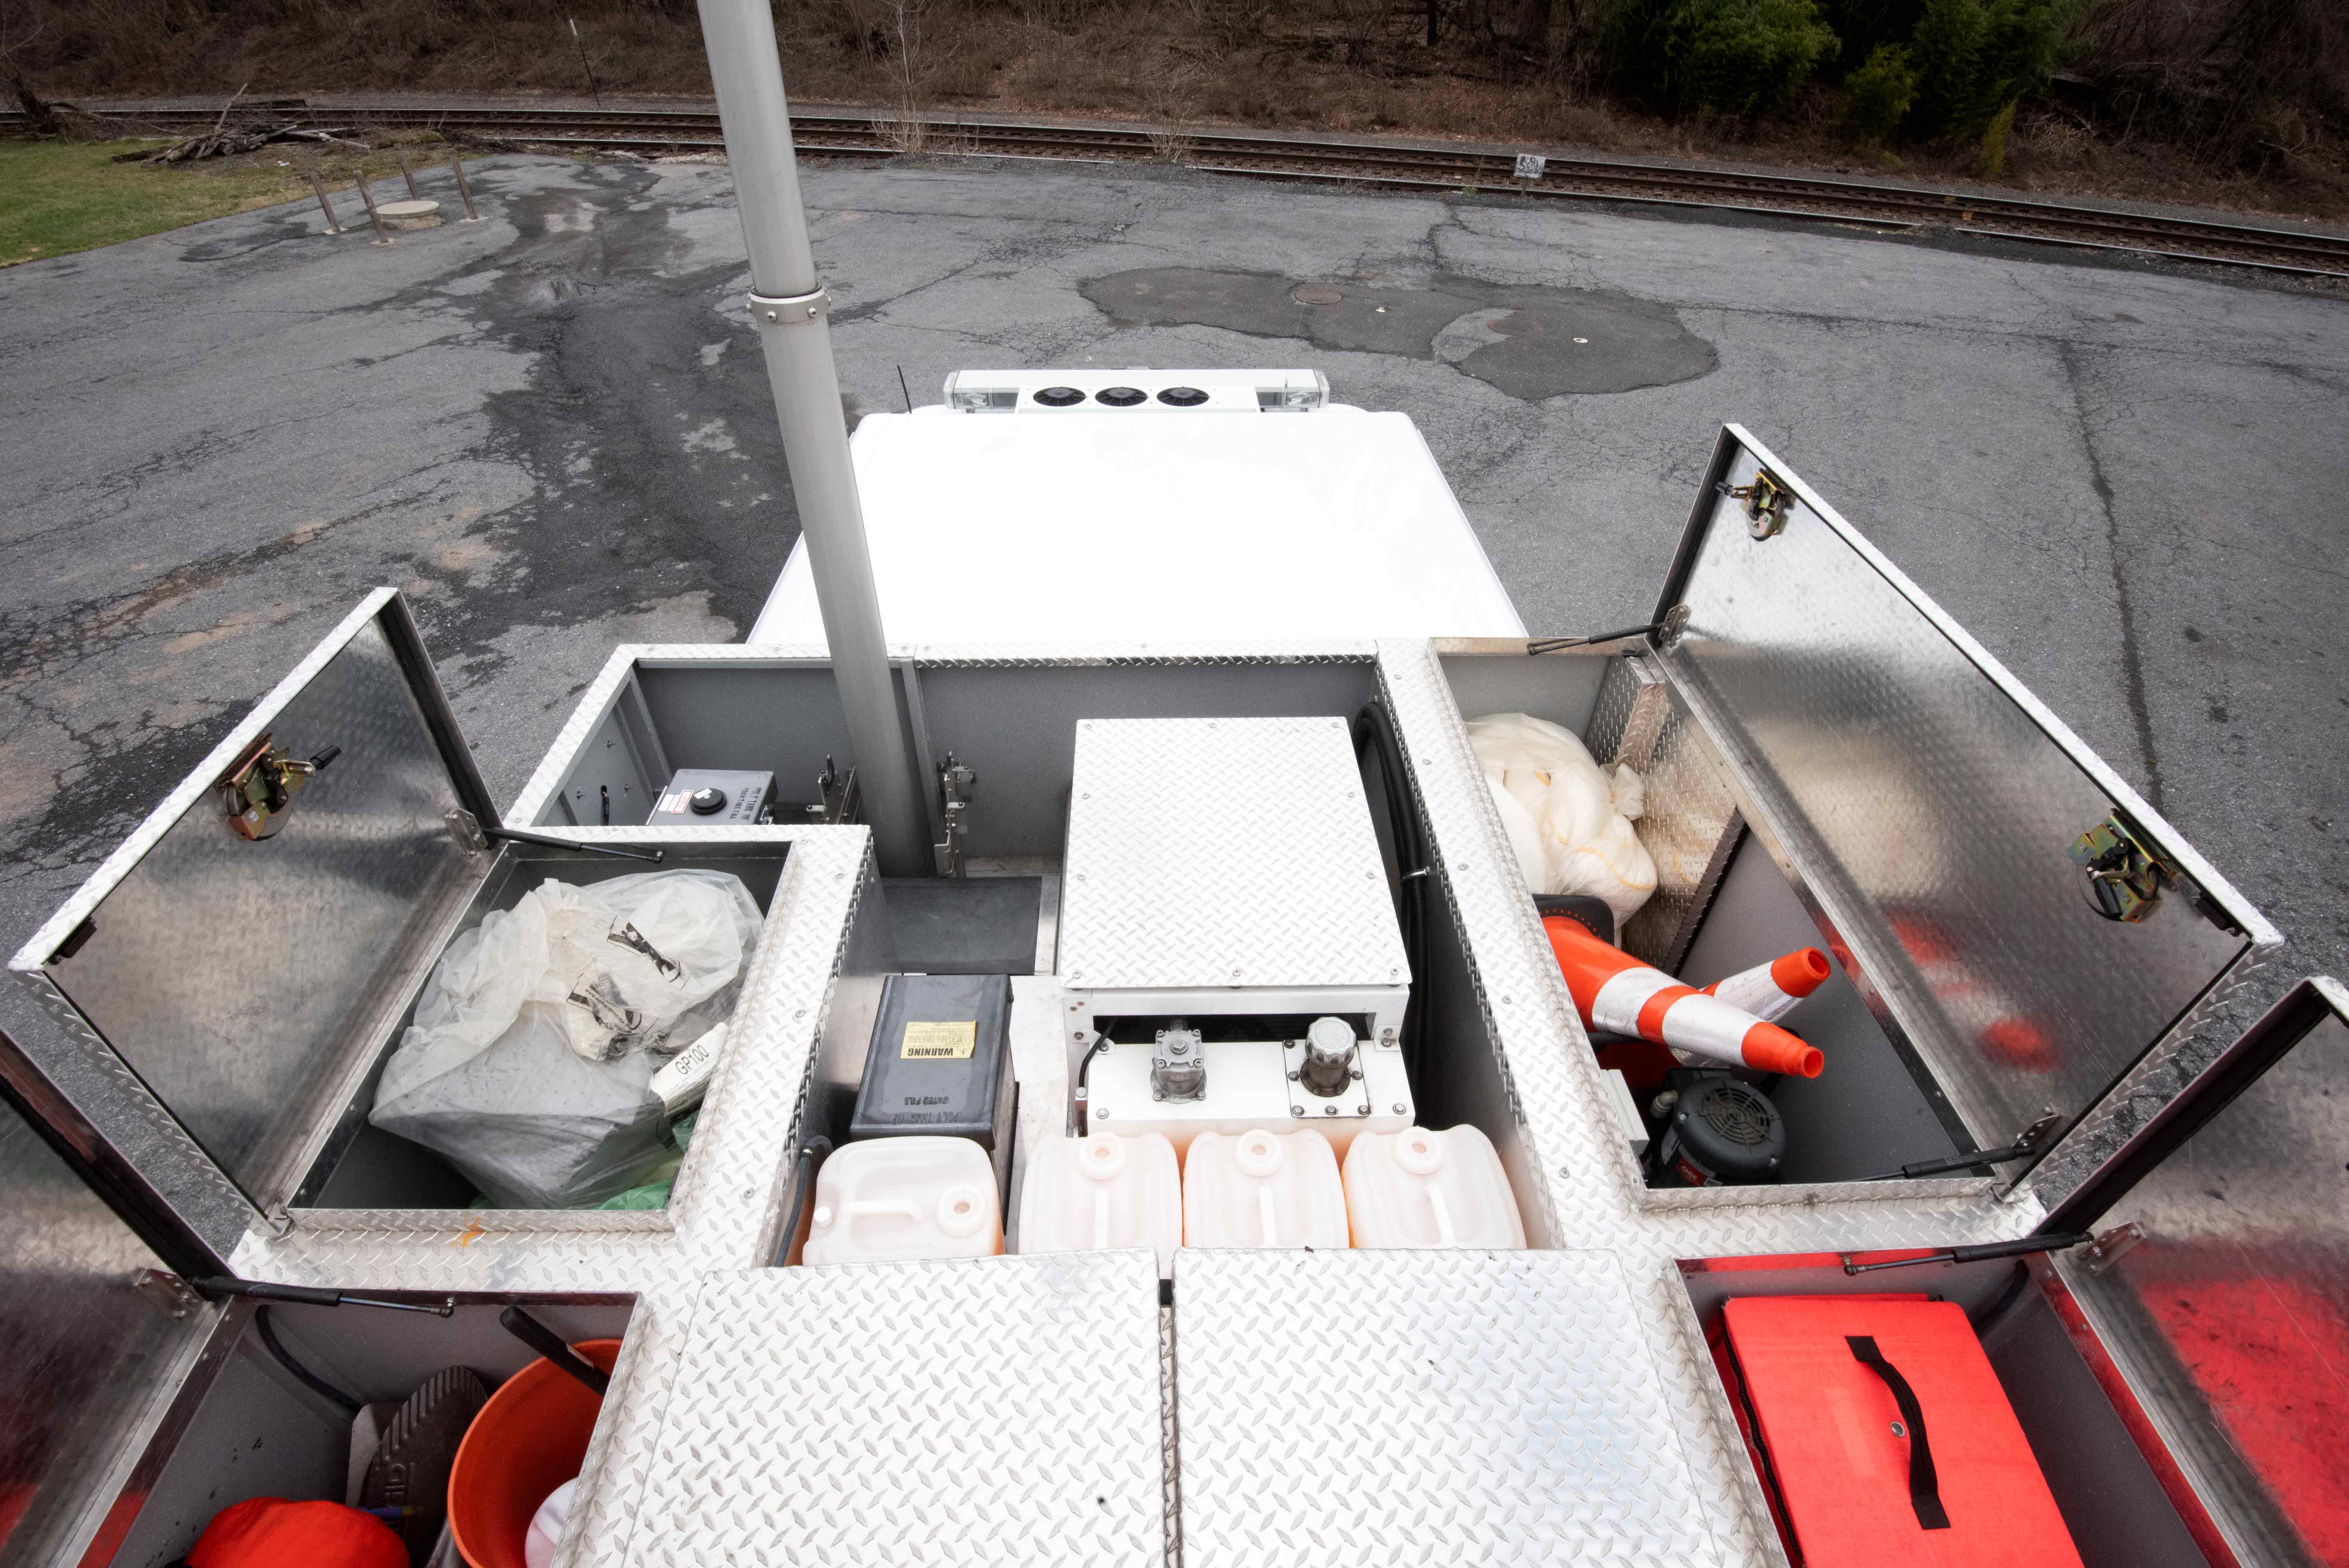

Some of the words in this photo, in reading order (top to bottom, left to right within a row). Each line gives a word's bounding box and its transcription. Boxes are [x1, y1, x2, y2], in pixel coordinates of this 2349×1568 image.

[908, 1048, 953, 1056] WARNING
[675, 1045, 709, 1074] GP100
[904, 1097, 921, 1106] FILL
